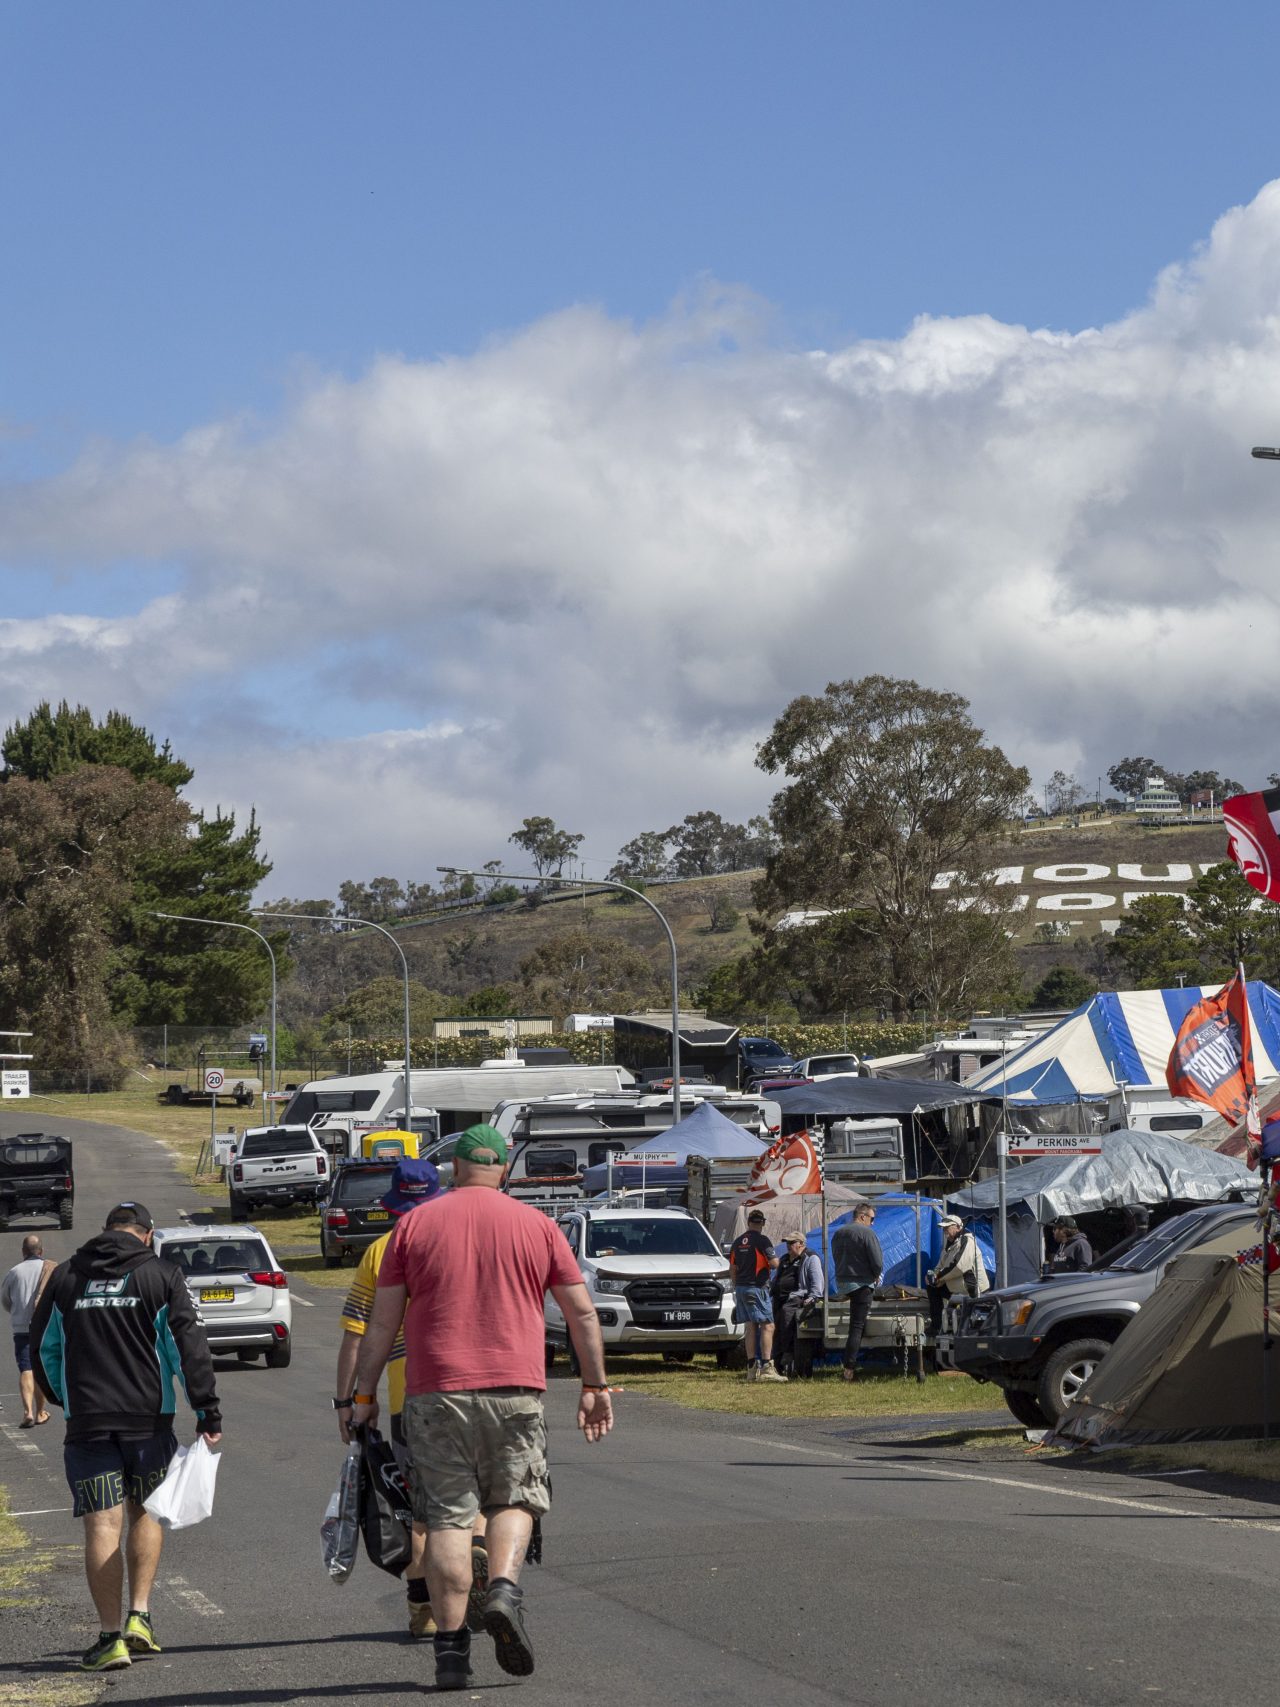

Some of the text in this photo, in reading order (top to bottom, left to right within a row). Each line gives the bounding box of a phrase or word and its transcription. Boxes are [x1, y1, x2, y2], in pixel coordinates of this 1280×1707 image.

[208, 1075, 221, 1085] 20
[1037, 1137, 1078, 1148] PERKINS
[633, 1152, 661, 1161] MURPHY
[262, 1164, 297, 1173] RAM
[74, 1297, 141, 1309] MOSTERT
